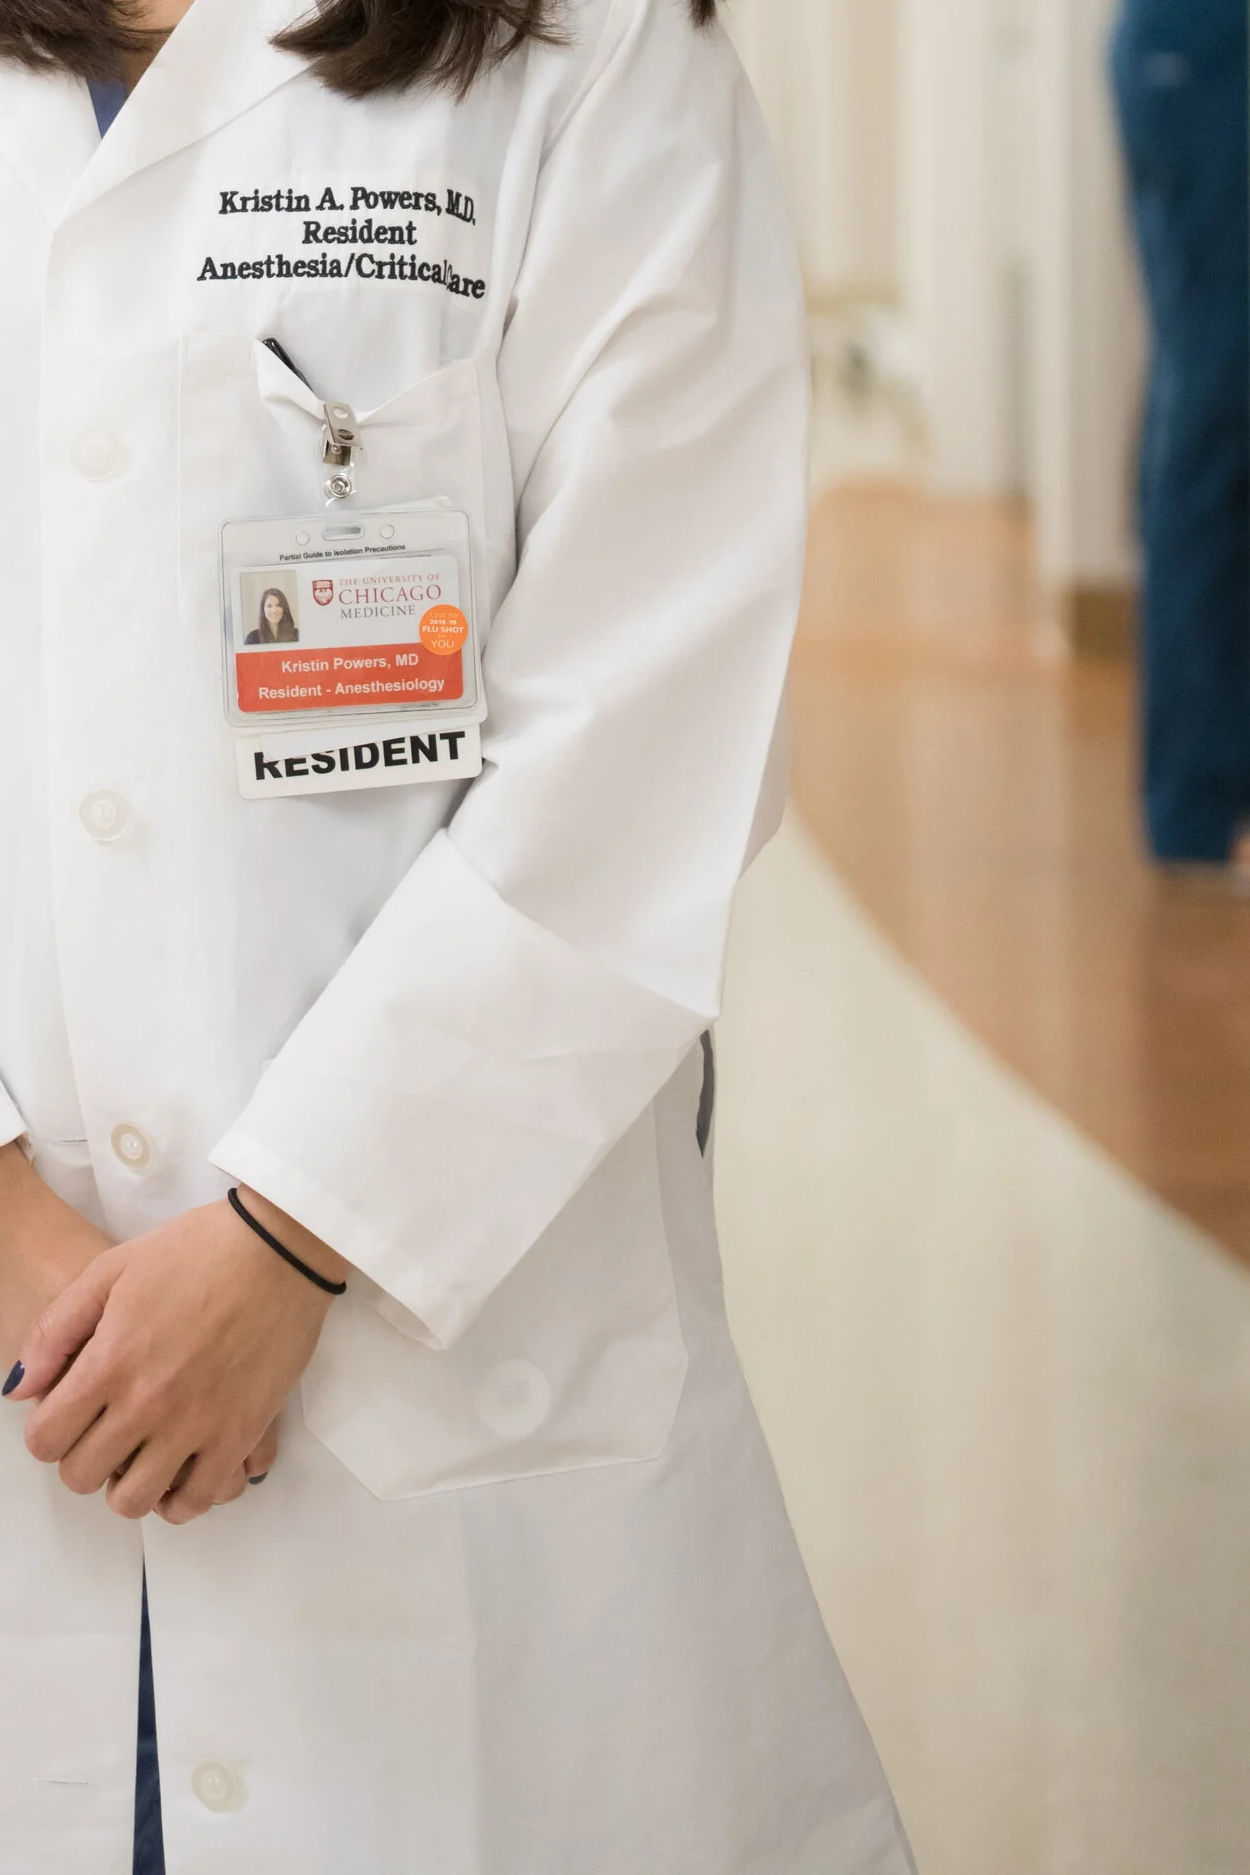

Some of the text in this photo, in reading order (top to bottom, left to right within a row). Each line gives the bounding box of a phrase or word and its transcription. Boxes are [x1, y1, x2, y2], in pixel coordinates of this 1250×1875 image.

[219, 189, 311, 214] Kristin
[315, 187, 344, 211] A.
[350, 186, 442, 216] Powers,
[302, 218, 418, 245] Resident
[197, 253, 448, 286] Anesthesia/Critical
[279, 553, 301, 561] Partial
[303, 551, 324, 559] Guide
[333, 547, 363, 557] Isolation
[365, 544, 406, 554] Precautions
[339, 573, 440, 586] THE UNIVERSITY OF
[338, 584, 442, 605] CHICAGO
[340, 604, 416, 620] MEDICINE
[422, 625, 439, 633] FLU
[431, 639, 455, 649] YOU
[281, 653, 419, 673] Kristin Powers, MD
[258, 685, 322, 700] Resident
[335, 678, 445, 695] Anesthesiology
[253, 730, 466, 781] RESIDENT
